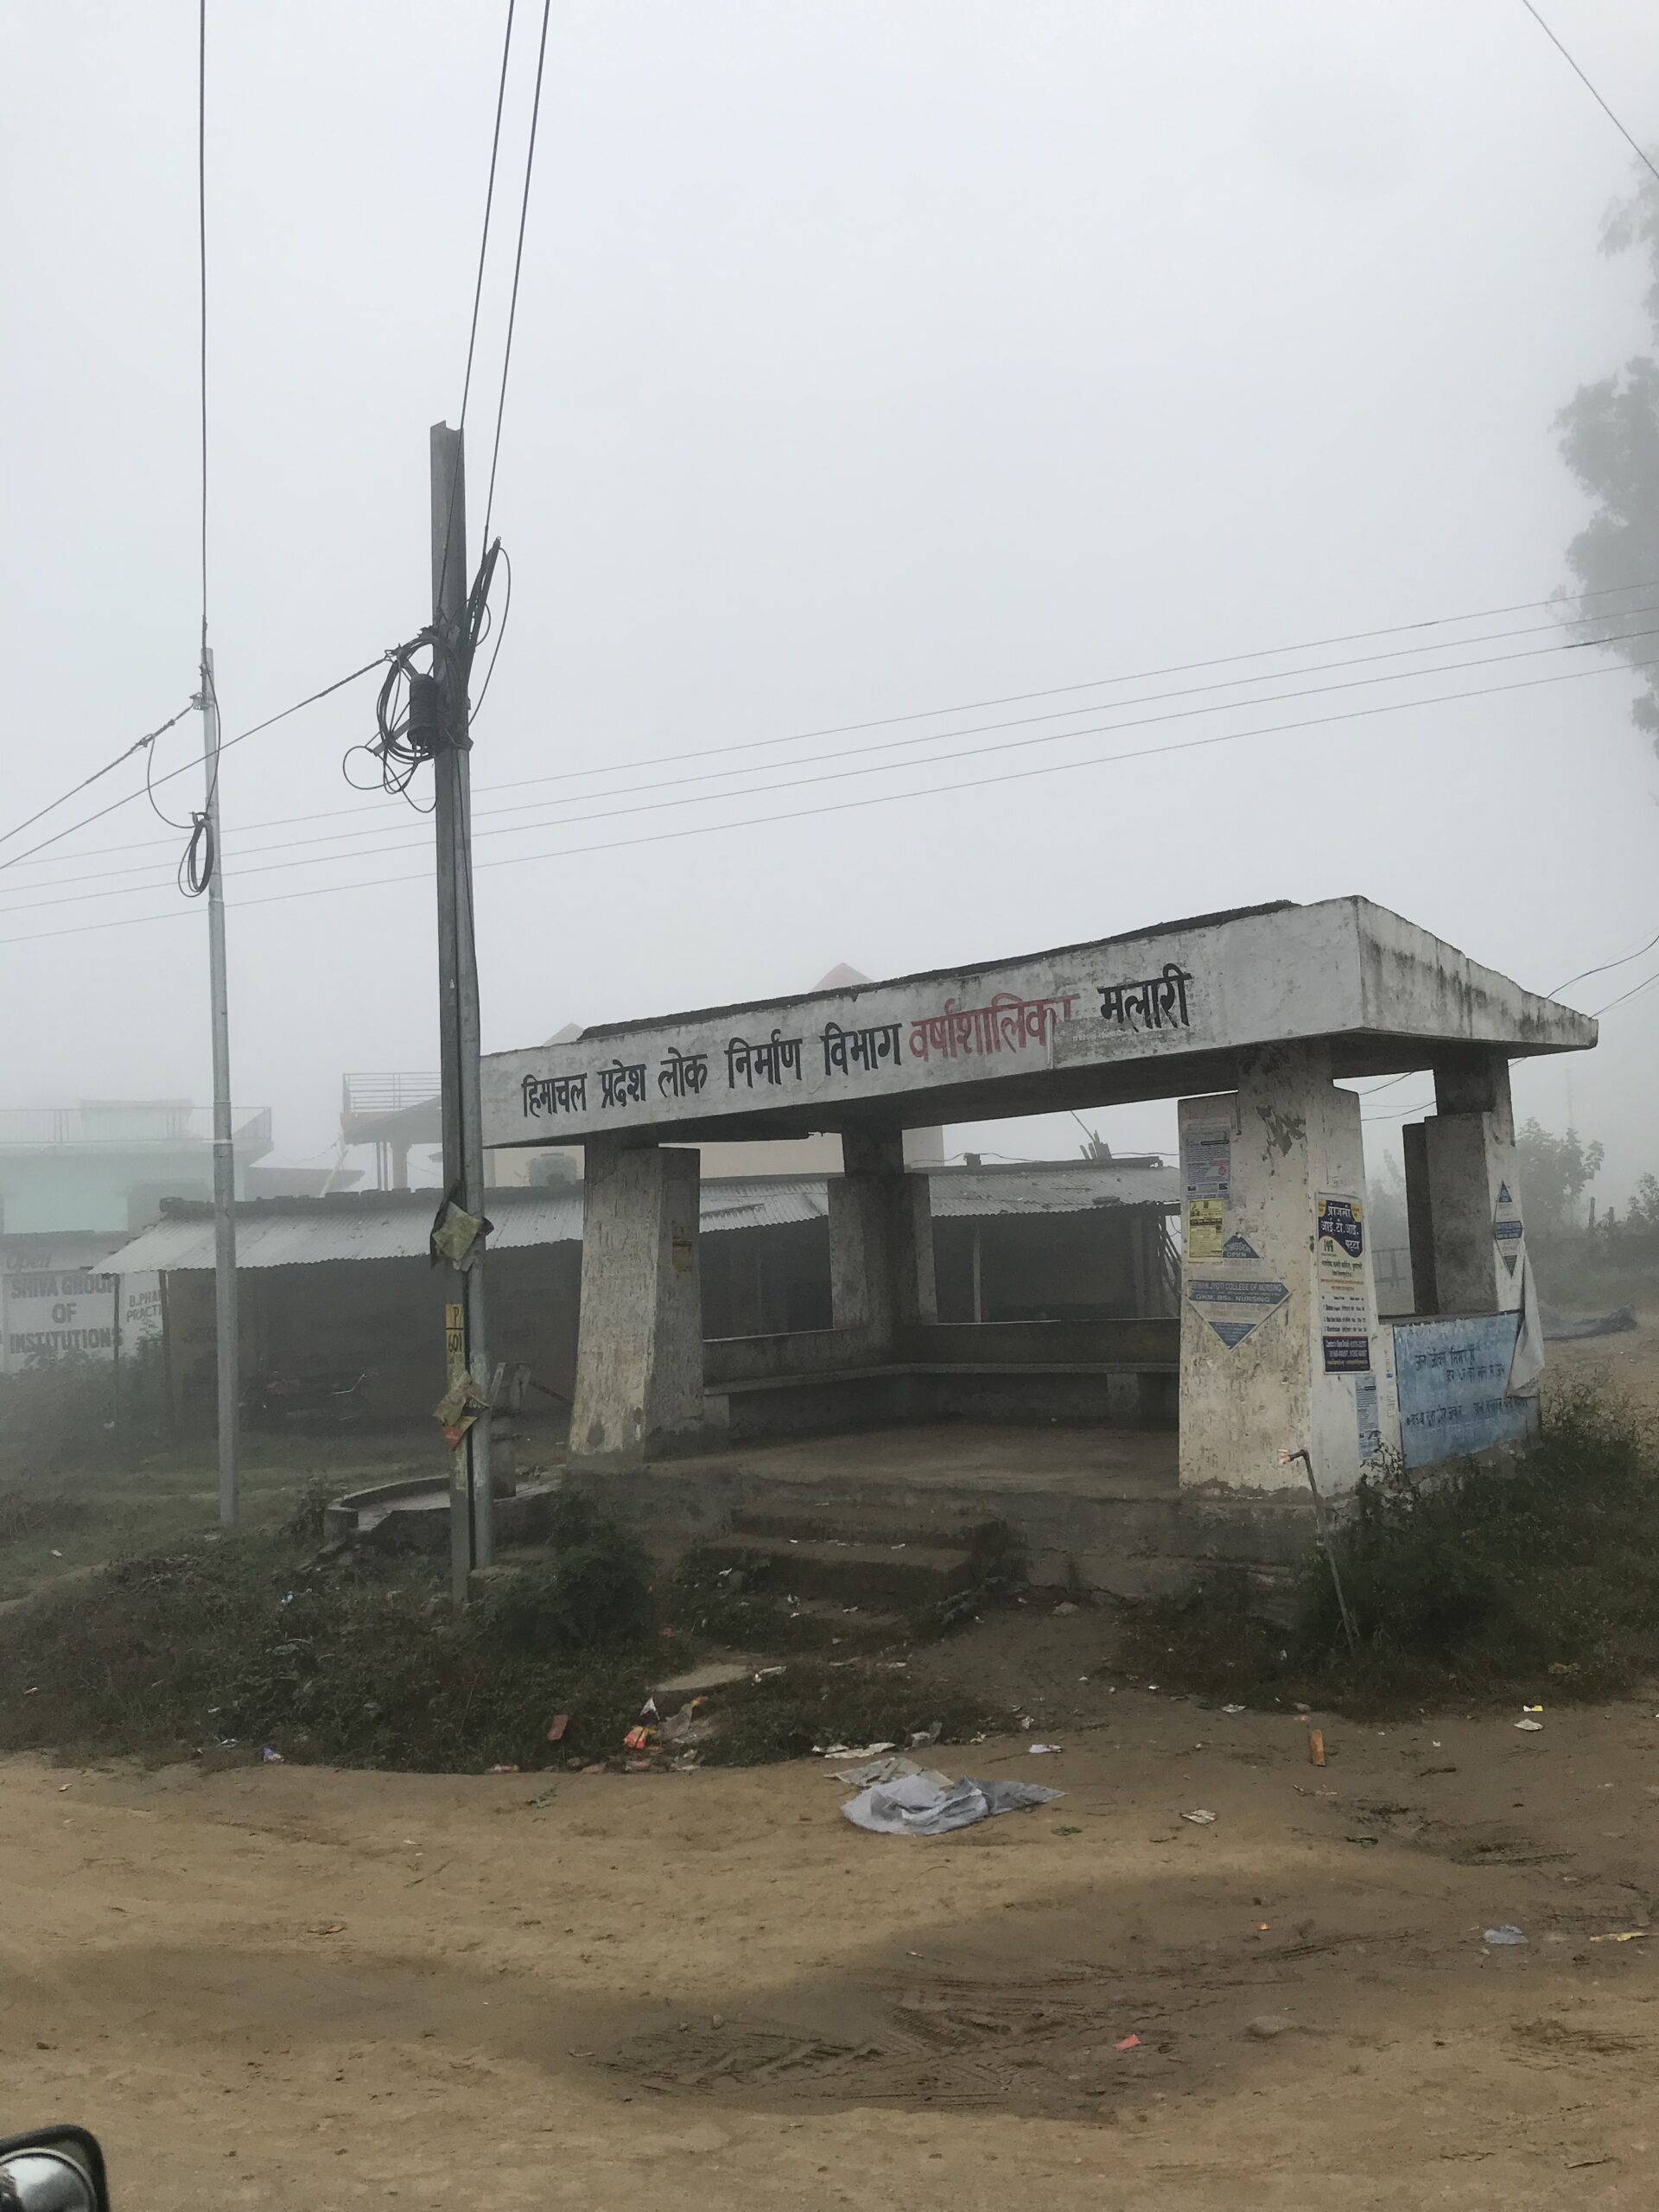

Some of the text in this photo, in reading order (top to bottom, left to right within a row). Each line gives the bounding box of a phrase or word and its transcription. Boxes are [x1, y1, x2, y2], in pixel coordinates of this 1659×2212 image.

[521, 1072, 588, 1117] हिमाचल
[596, 1059, 646, 1109] प्रदेश
[658, 1046, 708, 1098] लोक
[724, 1028, 803, 1089] निर्माण
[819, 1021, 902, 1077] विभाग
[11, 1274, 58, 1299] SHIVA
[52, 1302, 77, 1324] OF
[453, 1306, 460, 1328] P
